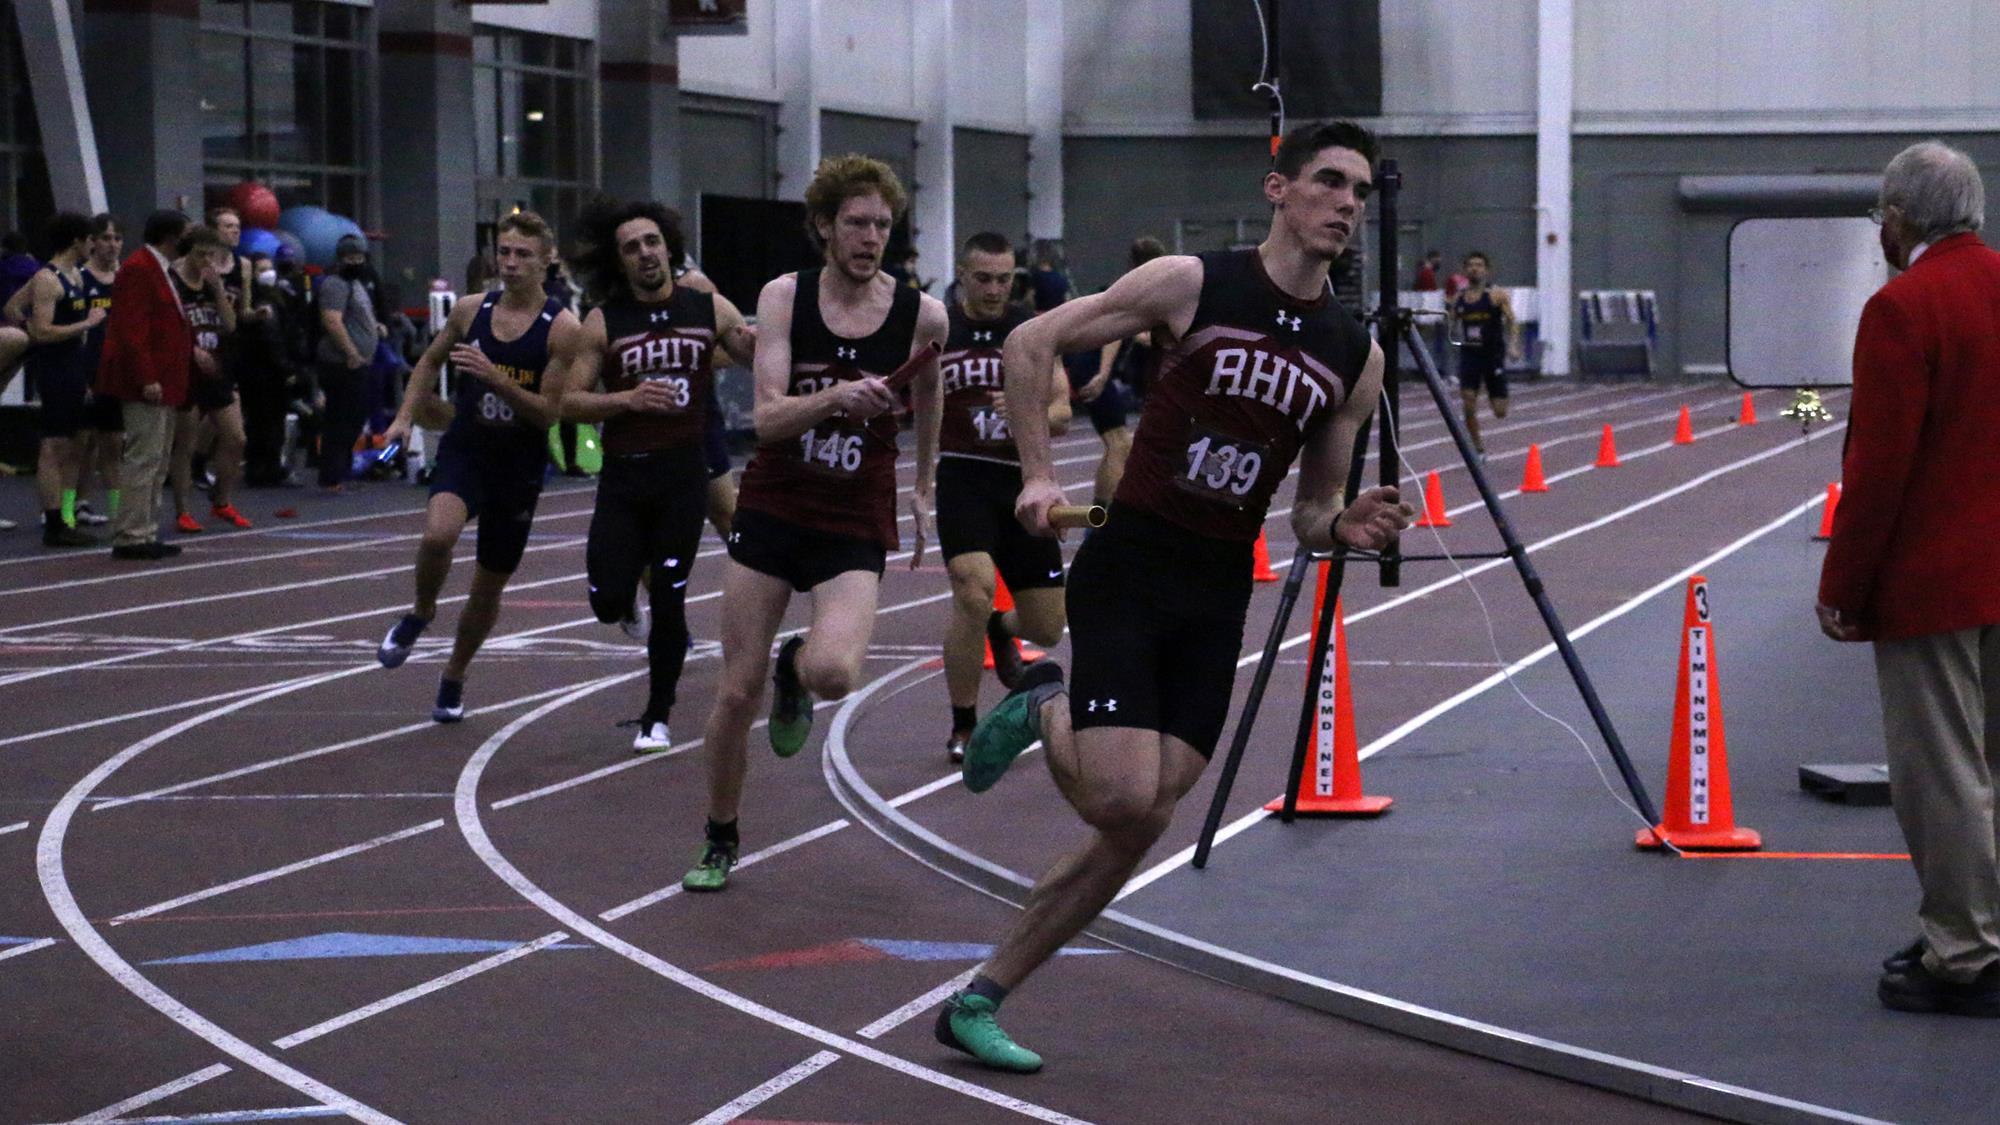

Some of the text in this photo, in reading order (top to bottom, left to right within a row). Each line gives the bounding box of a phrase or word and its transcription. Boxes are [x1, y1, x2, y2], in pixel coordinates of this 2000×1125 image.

[621, 337, 706, 378] RHIT
[941, 357, 1001, 395] RHI
[1204, 348, 1327, 432] RHIT
[800, 428, 863, 472] 146
[1187, 436, 1262, 495] 139
[1695, 586, 1709, 620] 3
